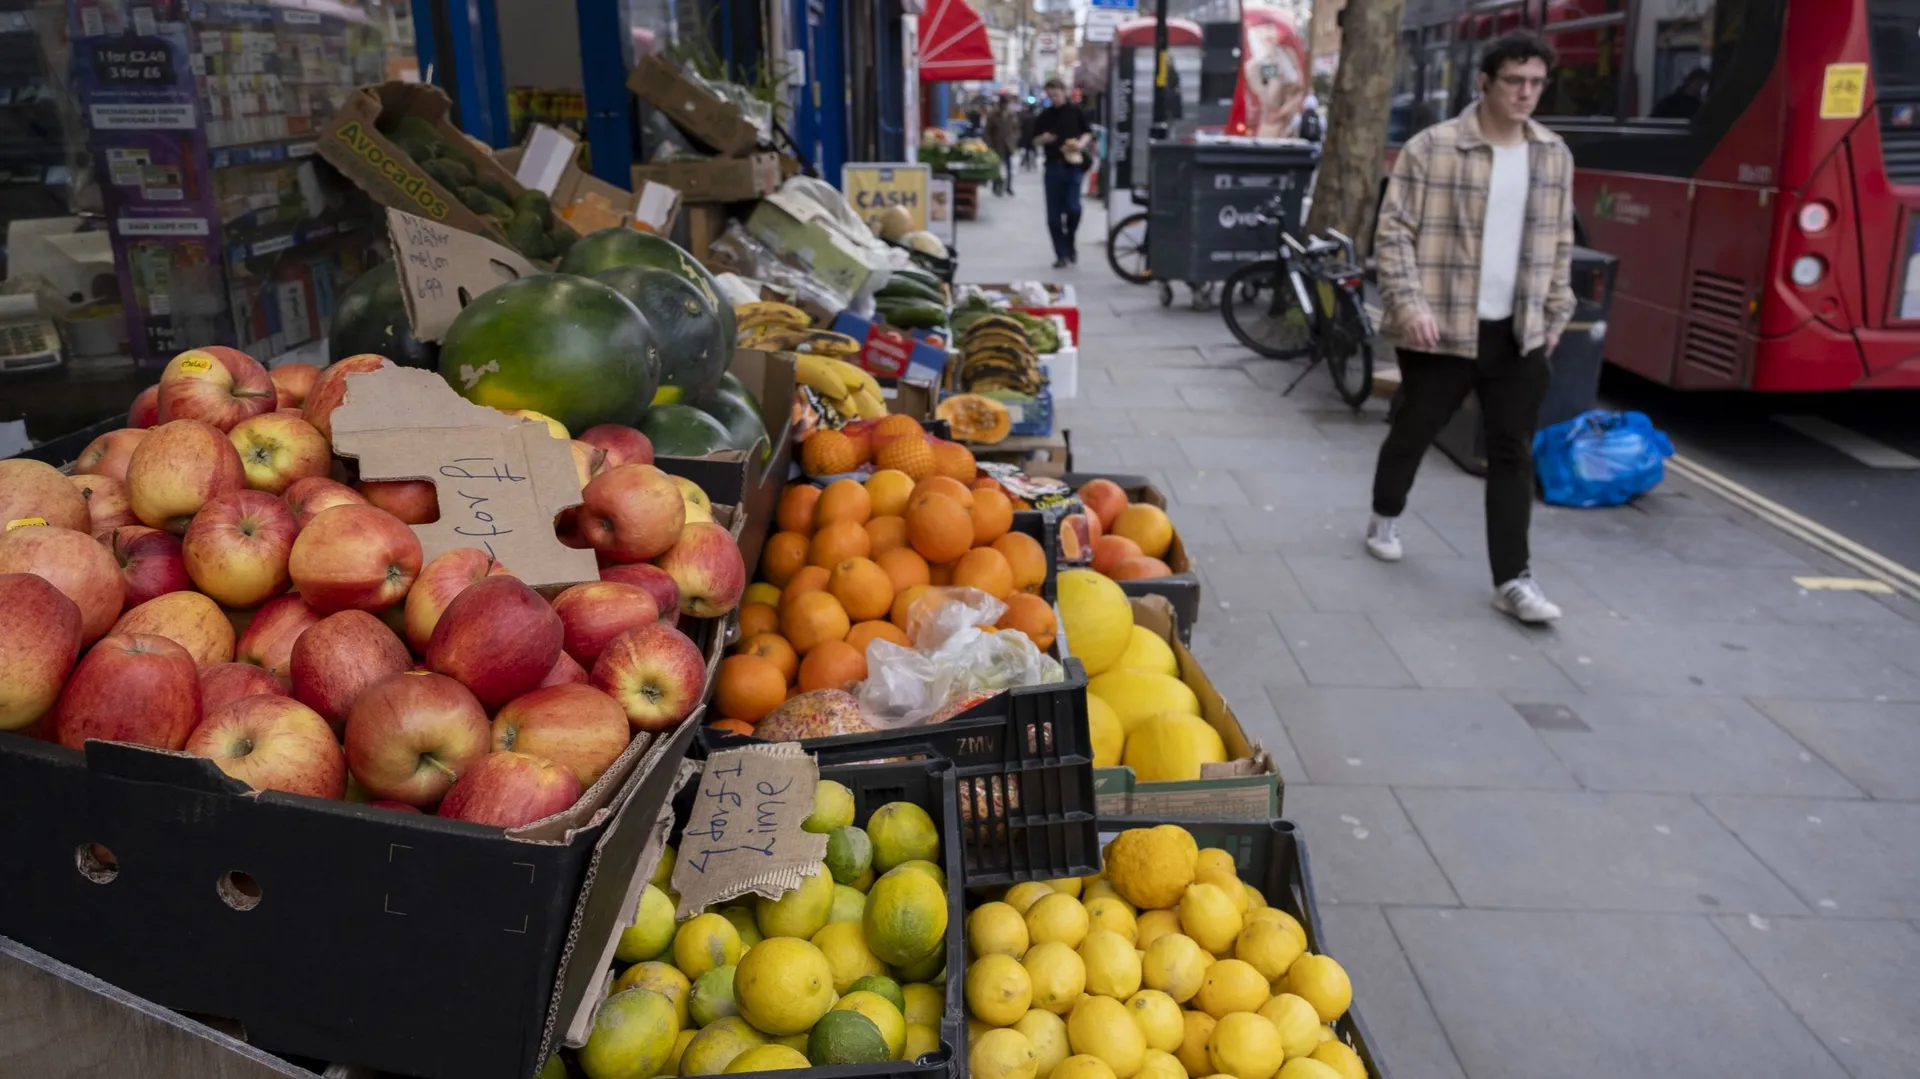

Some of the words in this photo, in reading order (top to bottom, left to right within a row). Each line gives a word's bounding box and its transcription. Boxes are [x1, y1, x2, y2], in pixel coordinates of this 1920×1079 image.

[107, 51, 126, 62] for
[129, 51, 167, 62] £2.49
[110, 67, 118, 78] 3
[120, 67, 141, 78] for
[143, 67, 161, 79] £6
[337, 122, 449, 219] Avocados
[855, 189, 918, 209] CASH
[454, 490, 513, 537] for
[686, 806, 730, 842] for
[740, 776, 795, 857] Lime
[688, 847, 738, 873] 4
